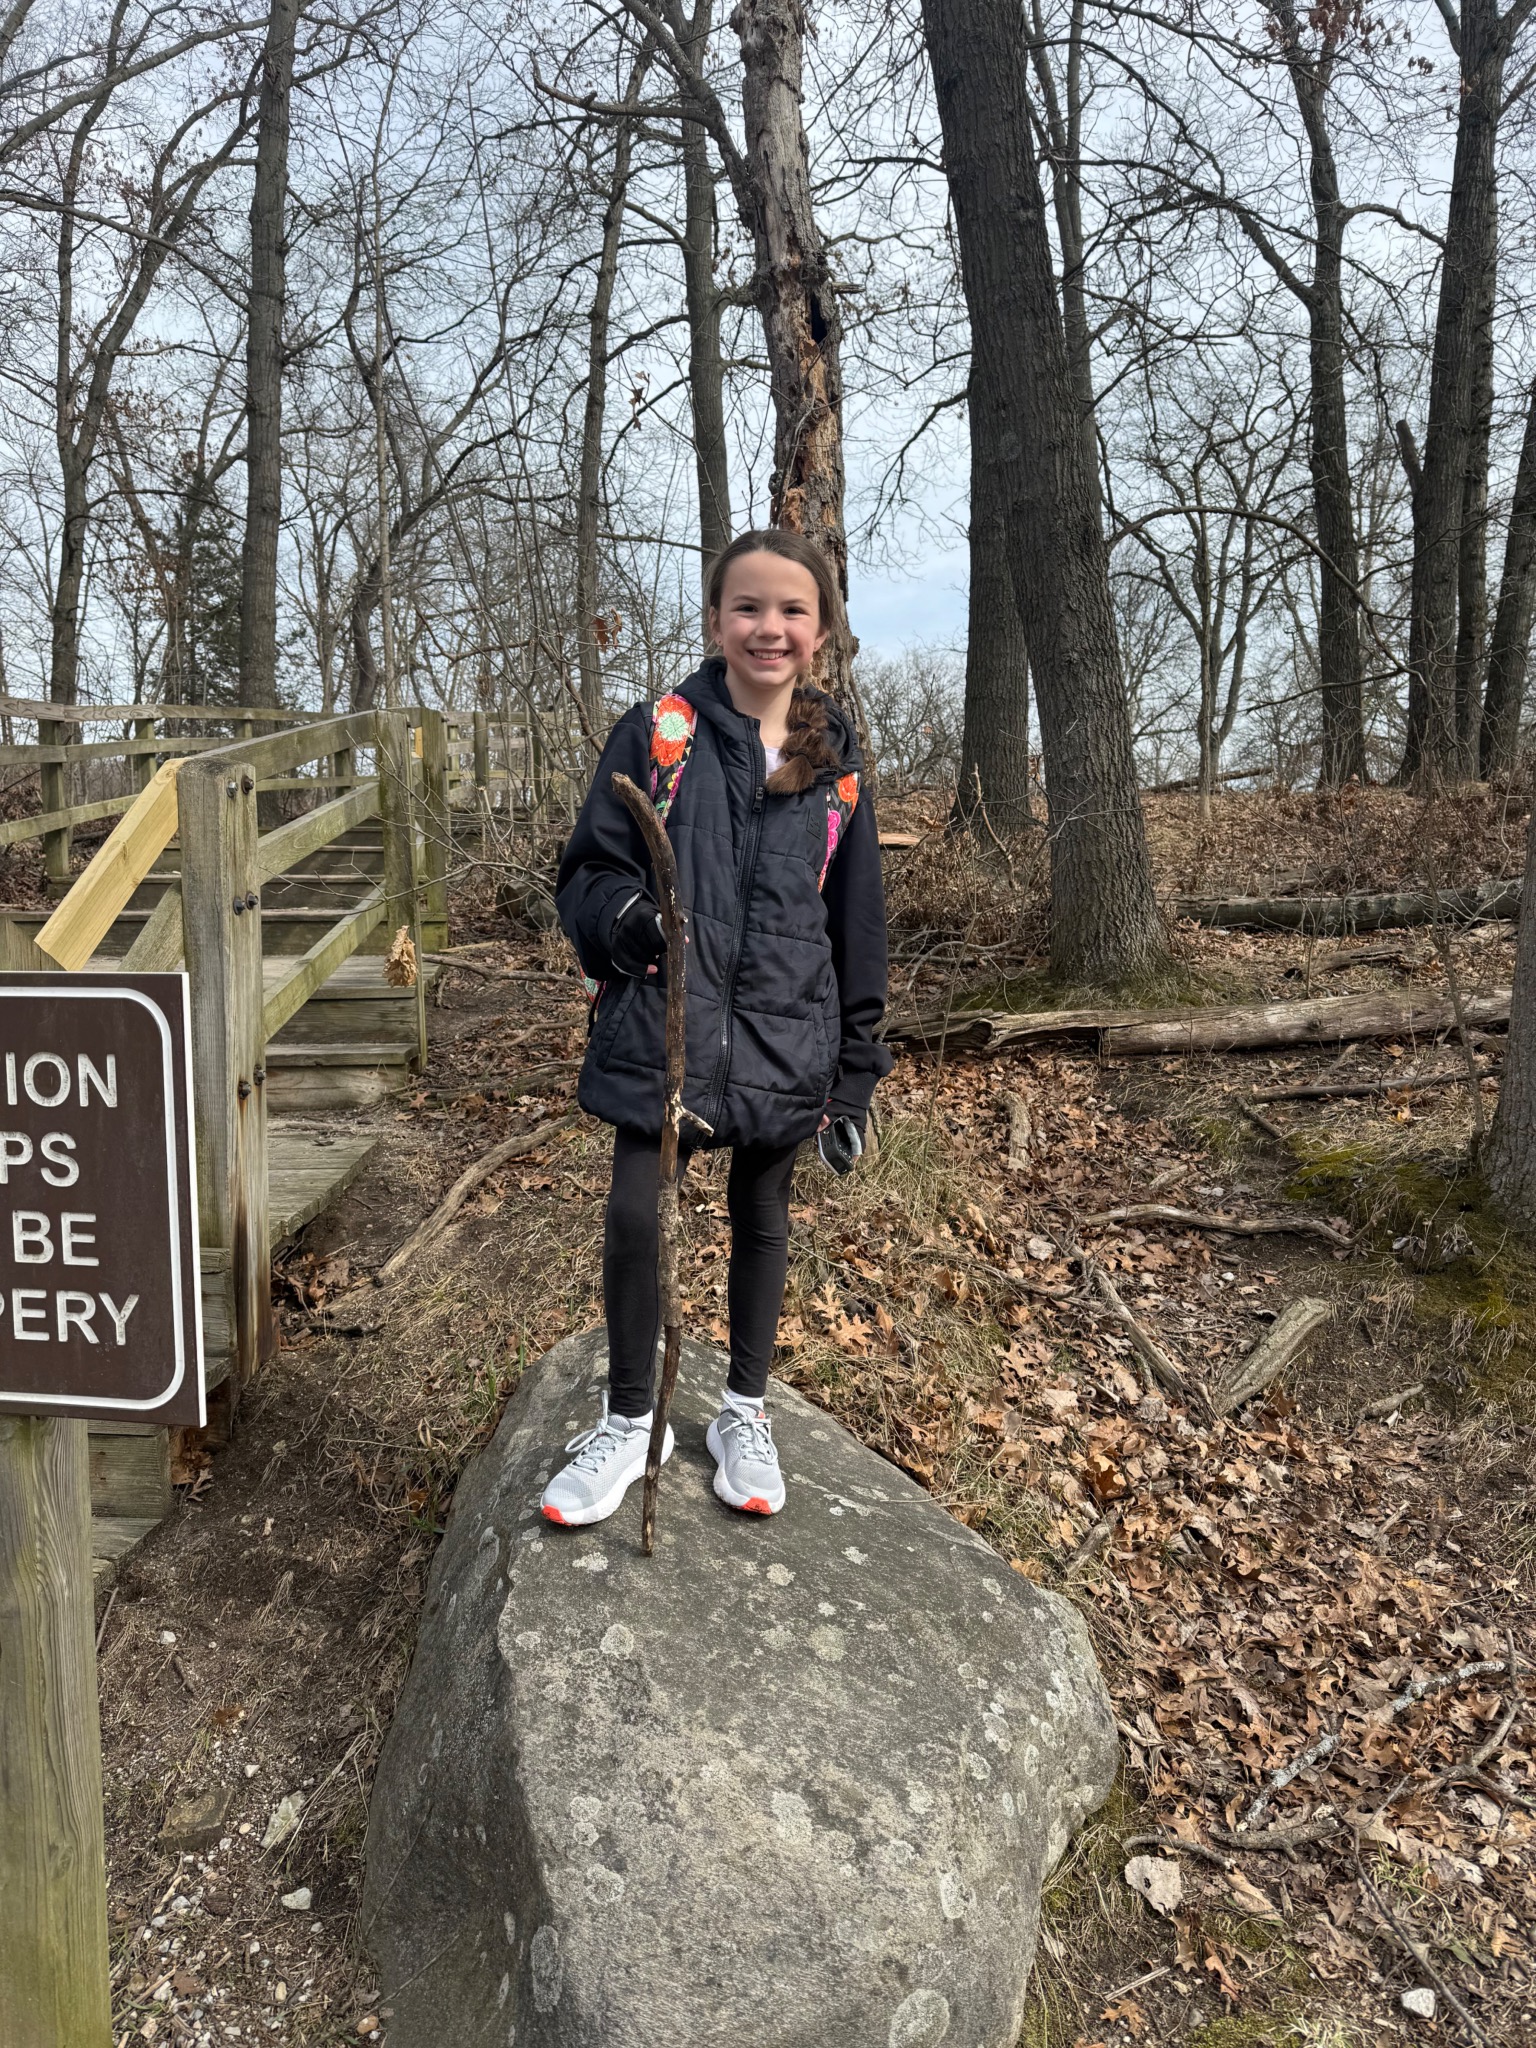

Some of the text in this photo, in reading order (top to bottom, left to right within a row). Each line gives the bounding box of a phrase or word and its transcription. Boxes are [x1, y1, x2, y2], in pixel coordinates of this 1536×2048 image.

[5, 1052, 118, 1108] ION
[0, 1131, 80, 1188] PS
[12, 1210, 100, 1267] BE
[0, 1288, 140, 1346] ERY
